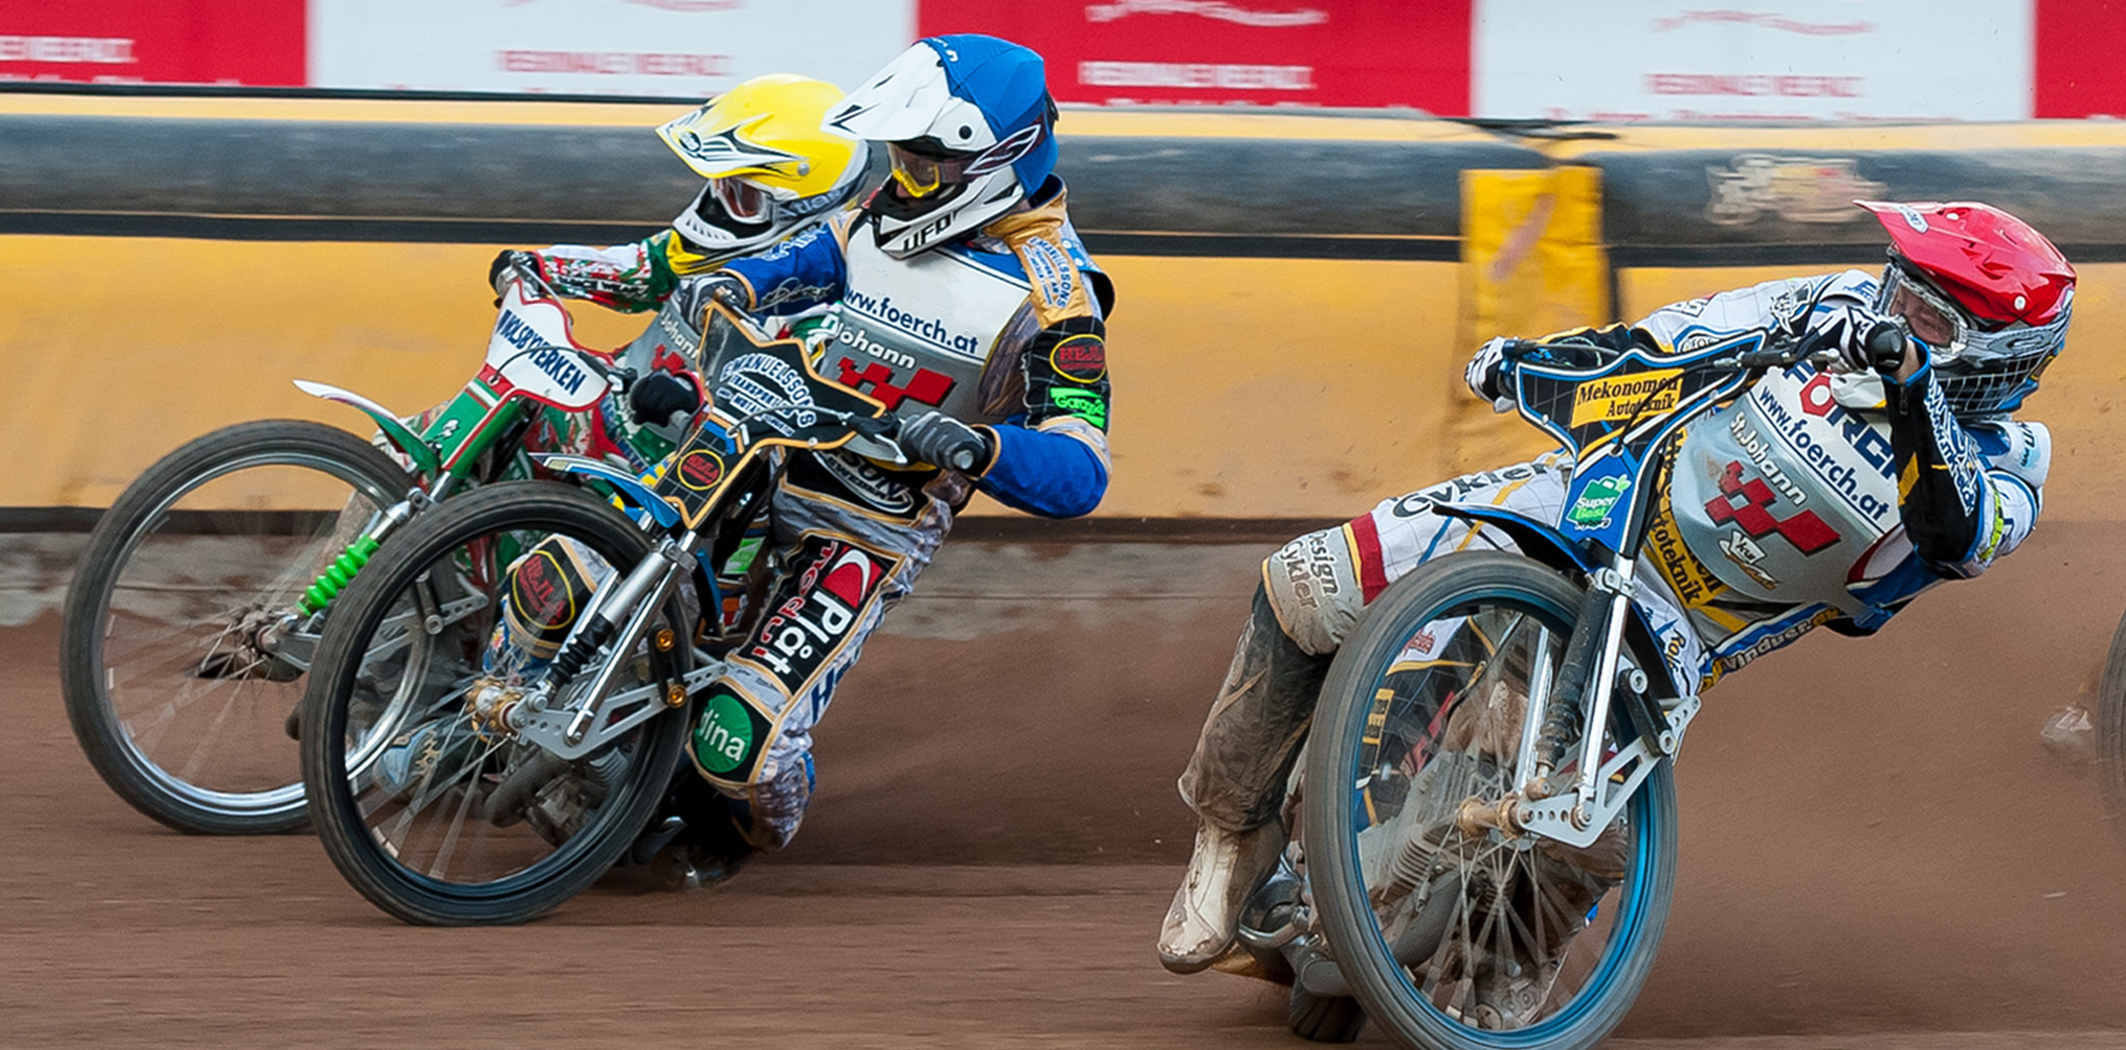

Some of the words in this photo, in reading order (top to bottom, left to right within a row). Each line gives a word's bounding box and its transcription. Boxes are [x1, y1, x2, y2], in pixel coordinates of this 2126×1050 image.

[903, 212, 952, 253] UFO
[1757, 385, 1890, 521] www.foerch.at
[1576, 497, 1616, 509] Super
[1280, 541, 1319, 609] Cykler
[772, 590, 855, 676] Plåt
